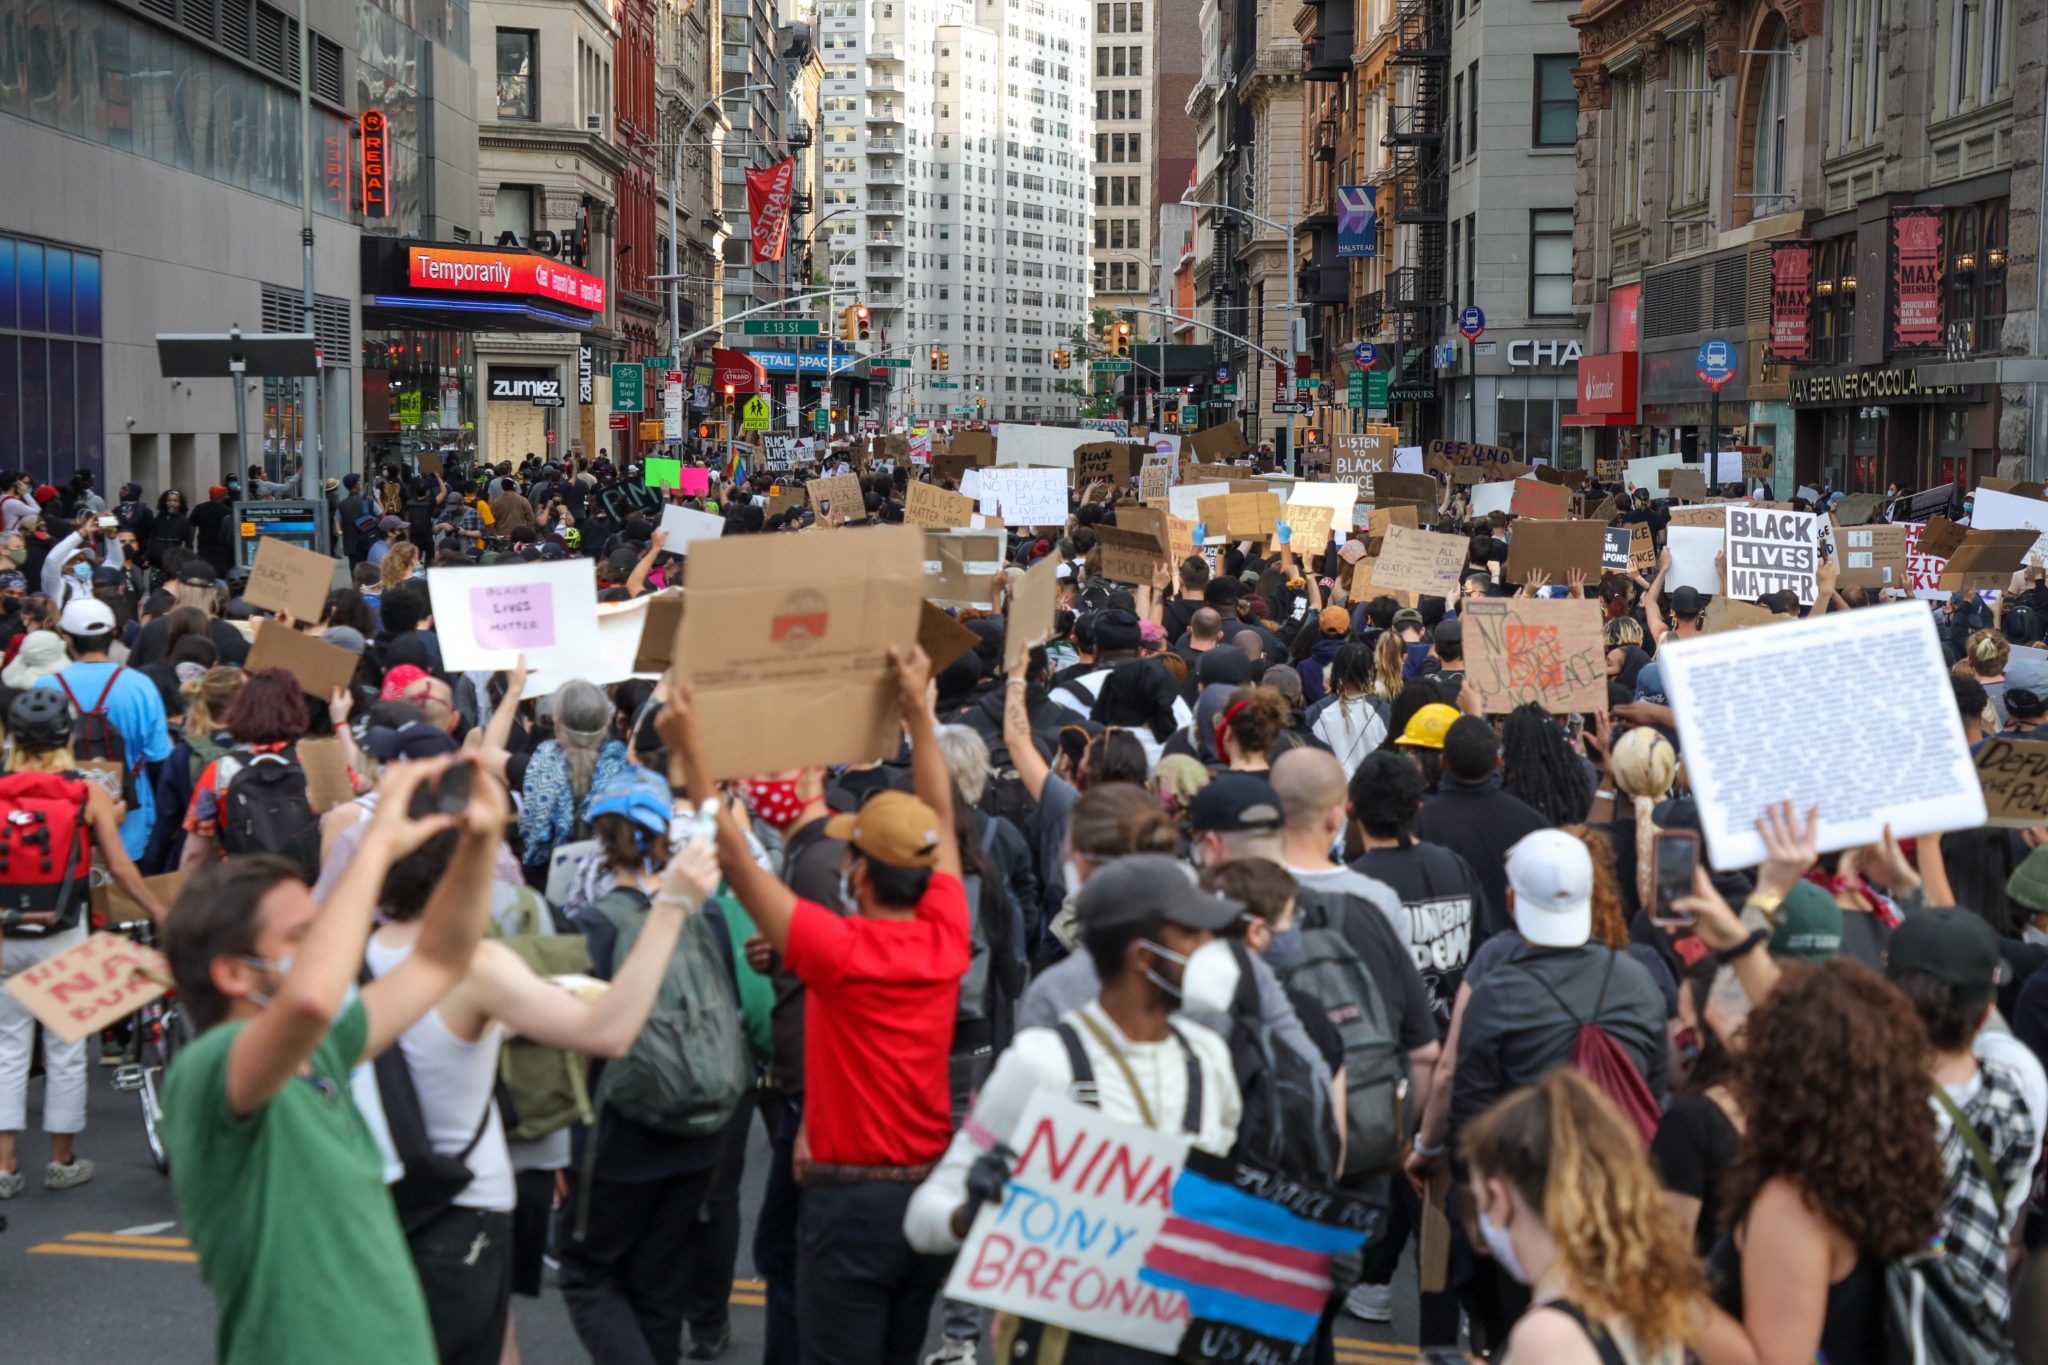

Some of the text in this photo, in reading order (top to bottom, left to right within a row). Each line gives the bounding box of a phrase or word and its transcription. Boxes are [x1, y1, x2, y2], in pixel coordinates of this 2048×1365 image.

[366, 137, 383, 202] REGAL
[753, 164, 791, 239] STRAND
[1338, 244, 1375, 252] HALSTEAD
[418, 255, 512, 288] Temporarily
[1901, 264, 1936, 284] MAX
[1901, 284, 1937, 294] BRENNER
[1776, 290, 1806, 306] MAX
[1901, 300, 1937, 309] CHOCOLATE
[1776, 307, 1805, 315] BRENNER
[1901, 309, 1914, 317] BAR
[763, 322, 799, 333] E 13 St
[1901, 316, 1937, 325] RESTAURANT
[752, 354, 795, 367] RETAIL
[799, 356, 838, 368] SPACE
[579, 346, 592, 403] zumiez
[493, 379, 559, 397] zumiez
[619, 381, 636, 389] West
[1591, 371, 1614, 400] Santander
[1810, 374, 1859, 401] BRENNER
[620, 389, 635, 397] Side
[1389, 390, 1434, 400] ANTIQUES
[746, 421, 767, 429] AHEAD
[764, 435, 789, 448] BLACK
[1338, 436, 1379, 449] LISTEN
[1080, 448, 1113, 464] BLACK
[1352, 449, 1366, 457] TO
[1433, 440, 1510, 465] DEFUND
[1150, 457, 1168, 466] NO
[1336, 458, 1383, 473] BLACK
[911, 486, 962, 513] NO LIVES
[1015, 492, 1065, 506] BLACK
[909, 504, 939, 521] MATTER
[1009, 504, 1049, 515] LIVES
[1730, 510, 1813, 543] BLACK
[1438, 547, 1456, 557] ALL
[1735, 543, 1810, 569] LIVES
[486, 586, 529, 597] BLACK
[1732, 569, 1814, 602] MATTER
[493, 600, 532, 614] LIVES
[488, 620, 539, 632] MATTER
[1475, 610, 1526, 657] NO
[1540, 647, 1604, 703] PEACE
[1013, 1117, 1172, 1211] NINA
[997, 1183, 1138, 1258] TONY
[966, 1233, 1194, 1327] BREONNA
[1200, 1324, 1242, 1361] US
